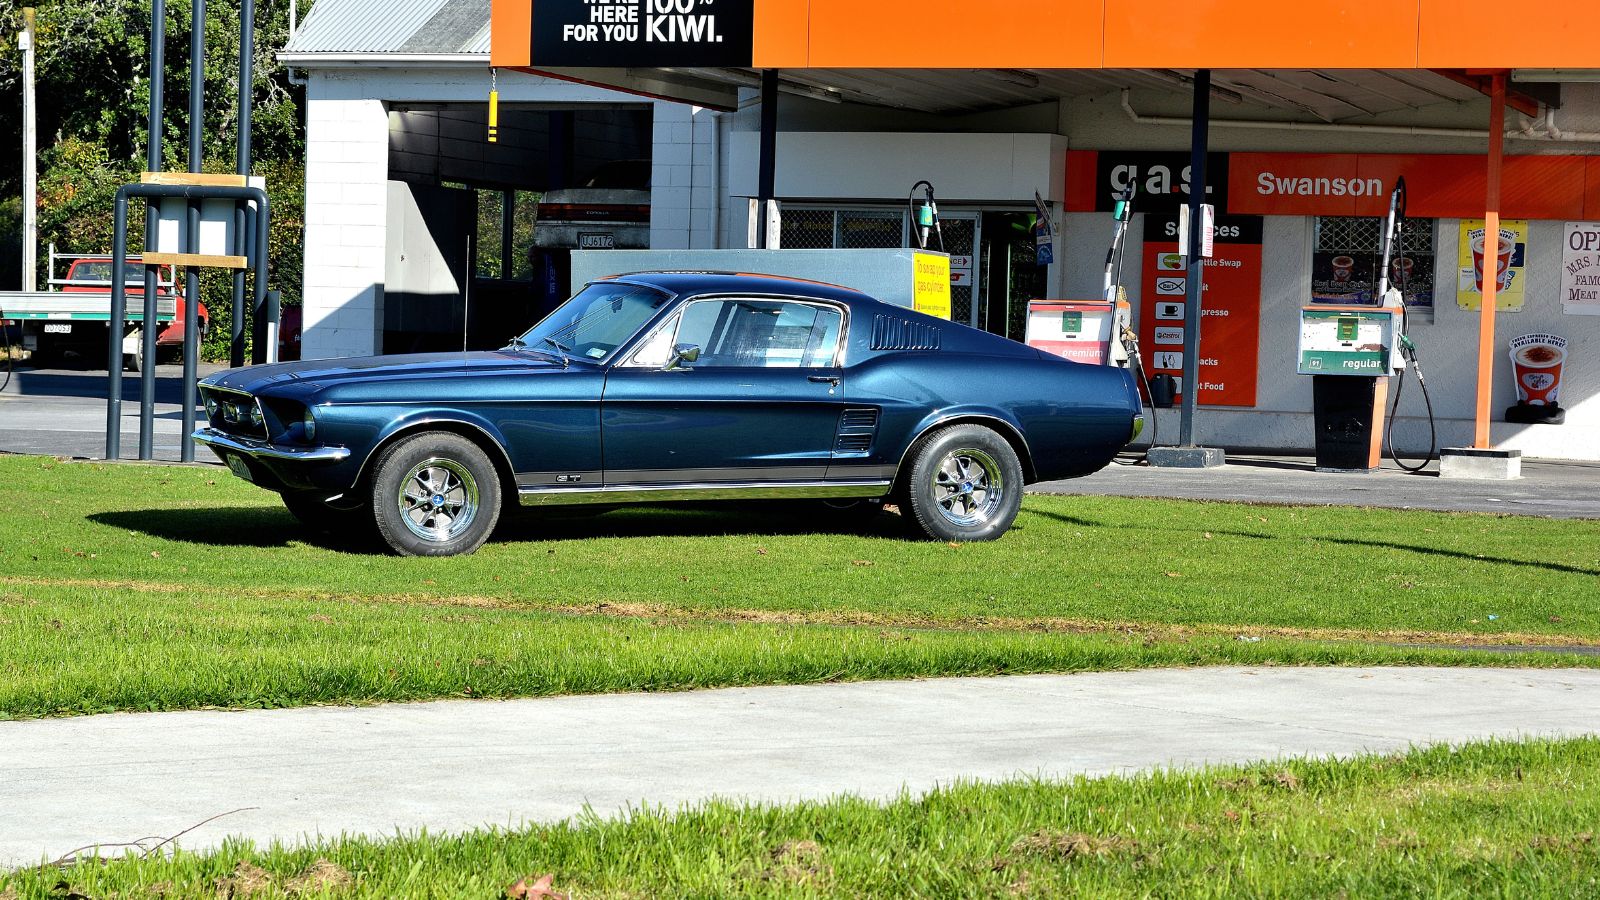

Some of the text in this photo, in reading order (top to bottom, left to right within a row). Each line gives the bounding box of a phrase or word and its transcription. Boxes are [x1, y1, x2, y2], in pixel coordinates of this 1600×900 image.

[591, 5, 639, 23] HERE
[563, 24, 639, 42] FOR YOU
[646, 14, 723, 42] KIWI.
[1256, 171, 1383, 197] Swanson
[582, 235, 613, 247] UJ6172
[1219, 258, 1242, 269] Swap
[1566, 256, 1593, 276] MRS.
[1062, 347, 1103, 358] premium
[1343, 358, 1382, 370] regular
[1204, 382, 1224, 391] Food
